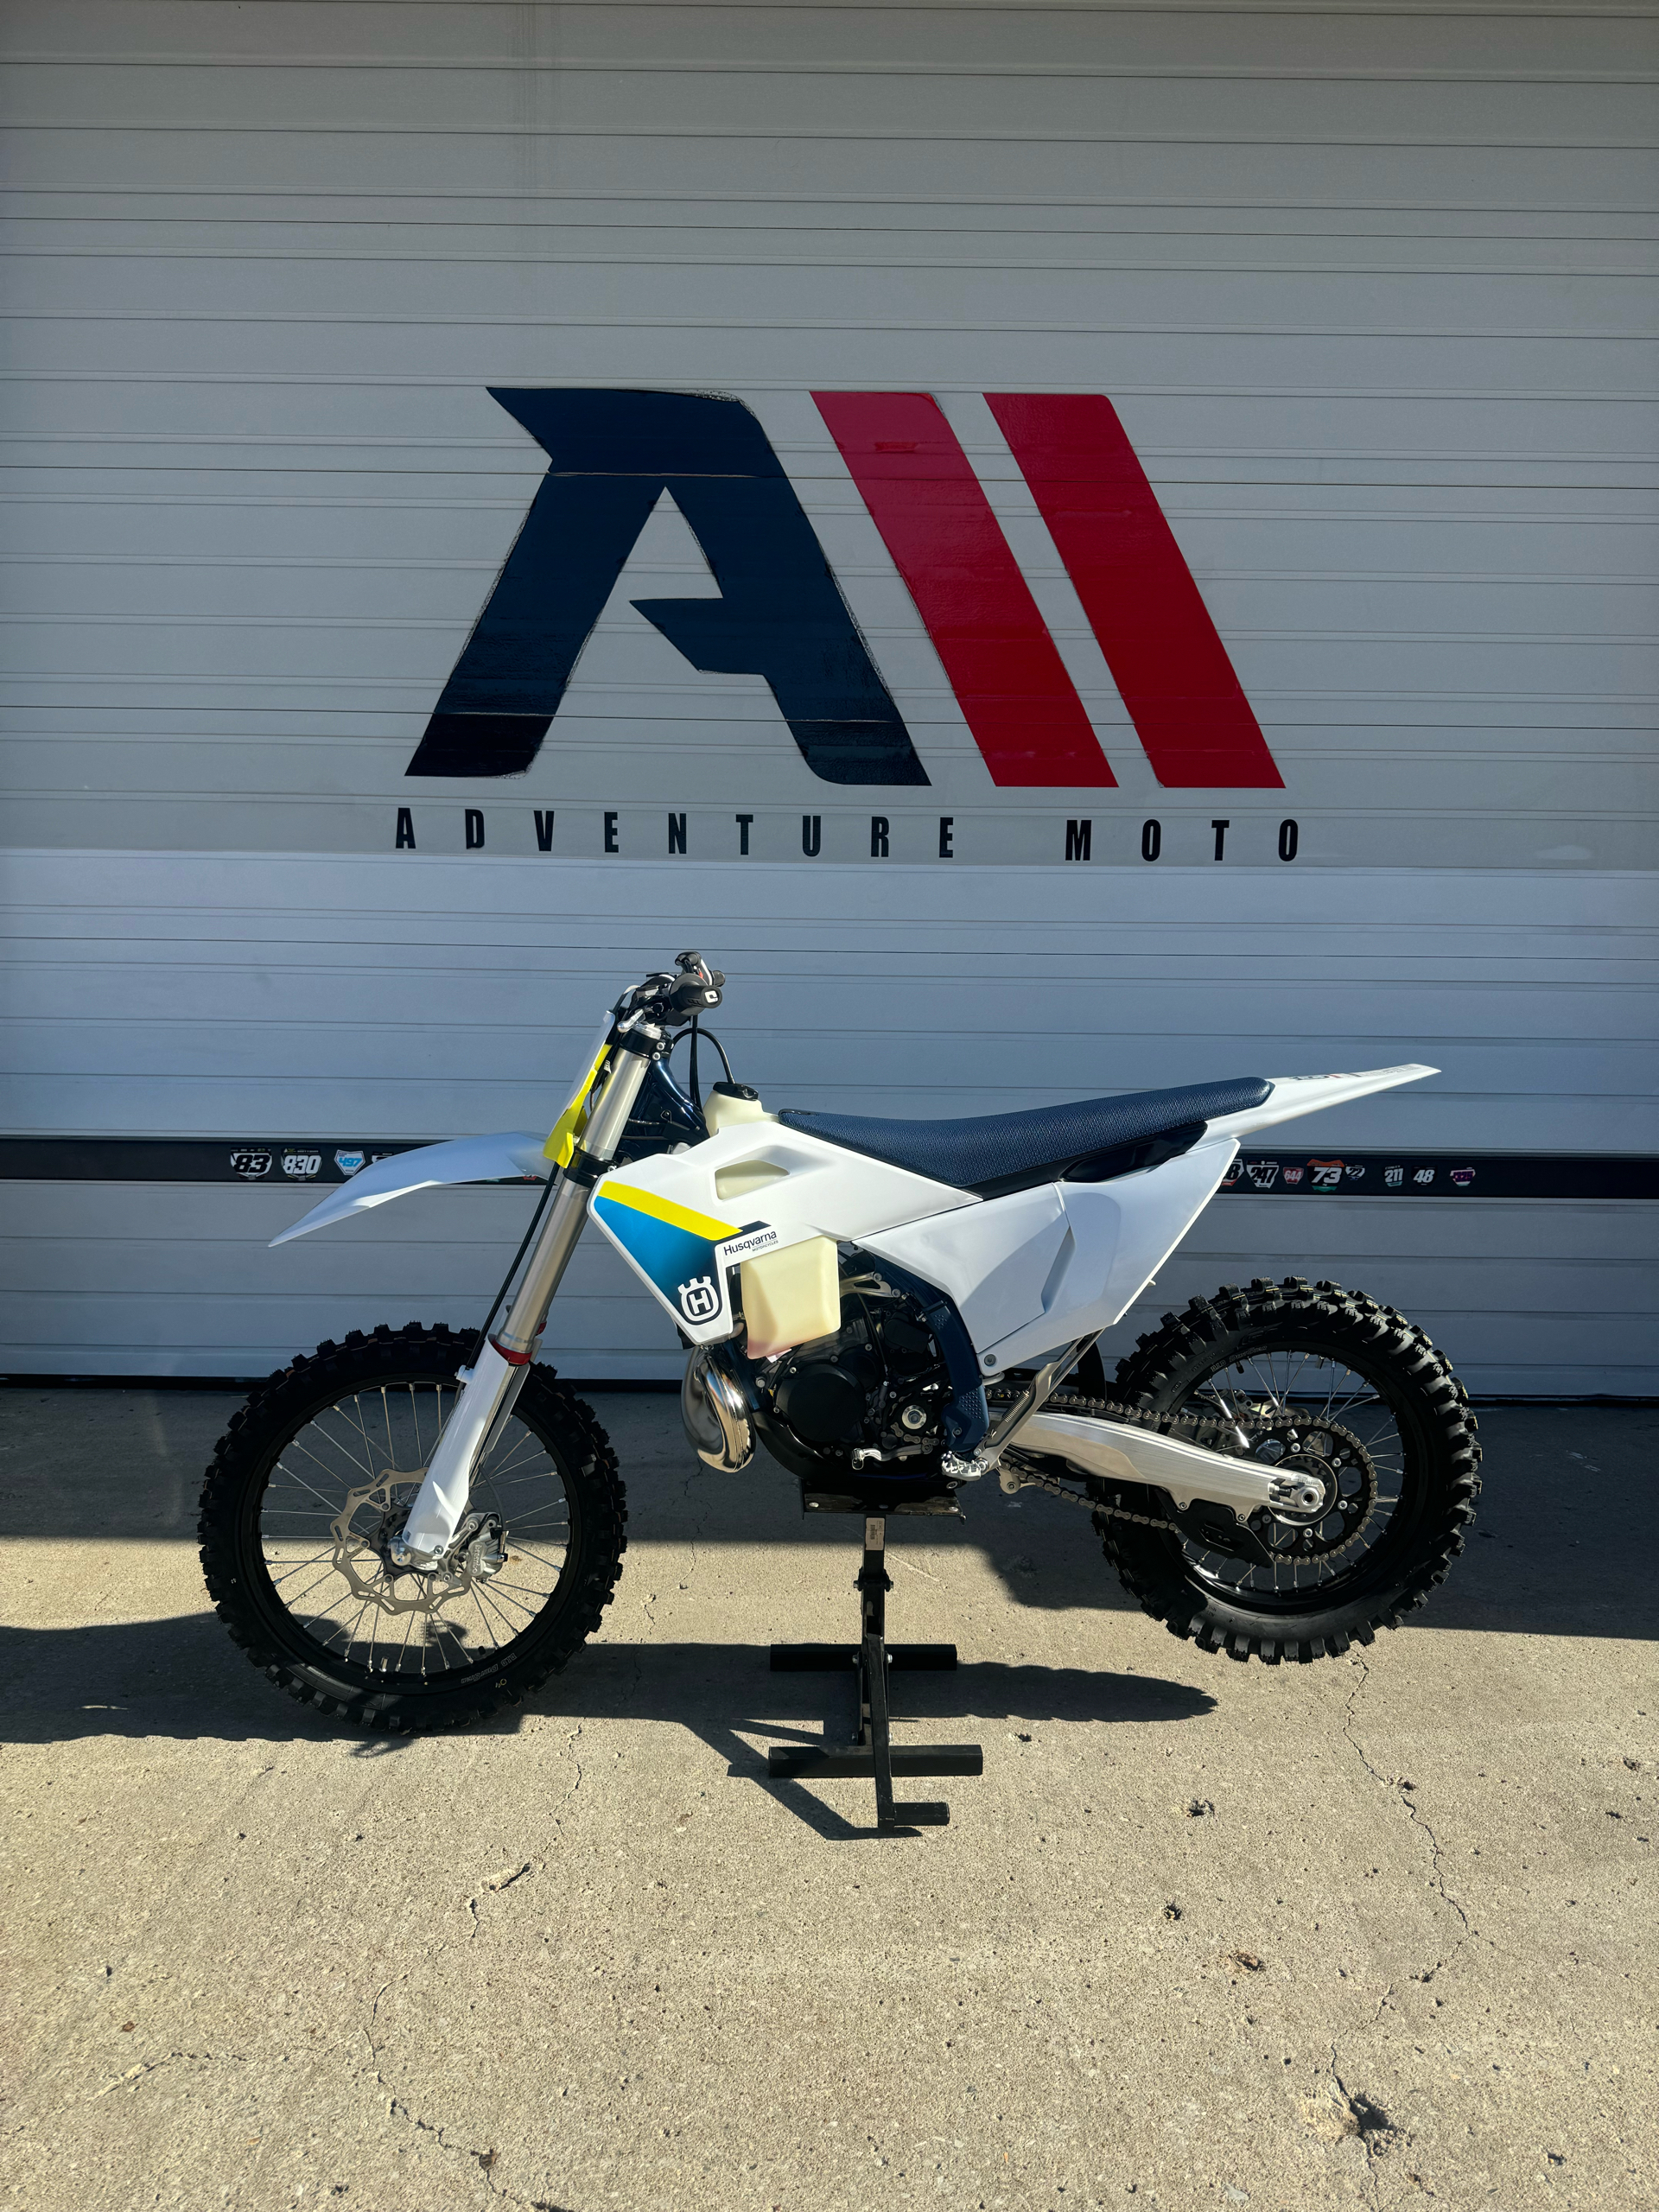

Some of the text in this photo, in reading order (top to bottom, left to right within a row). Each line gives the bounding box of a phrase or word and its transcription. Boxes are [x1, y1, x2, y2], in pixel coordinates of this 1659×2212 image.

[396, 807, 1299, 862] ADVENTURE MOTO
[233, 1154, 271, 1173] 83
[283, 1154, 322, 1174] 830
[338, 1157, 363, 1167] 497
[1250, 1166, 1278, 1184] 247
[1311, 1166, 1343, 1184] 73
[1384, 1167, 1404, 1183] 211
[1413, 1169, 1435, 1183] 48
[723, 1230, 778, 1256] Husqvarna
[752, 1240, 779, 1252] MOTORCYCLES
